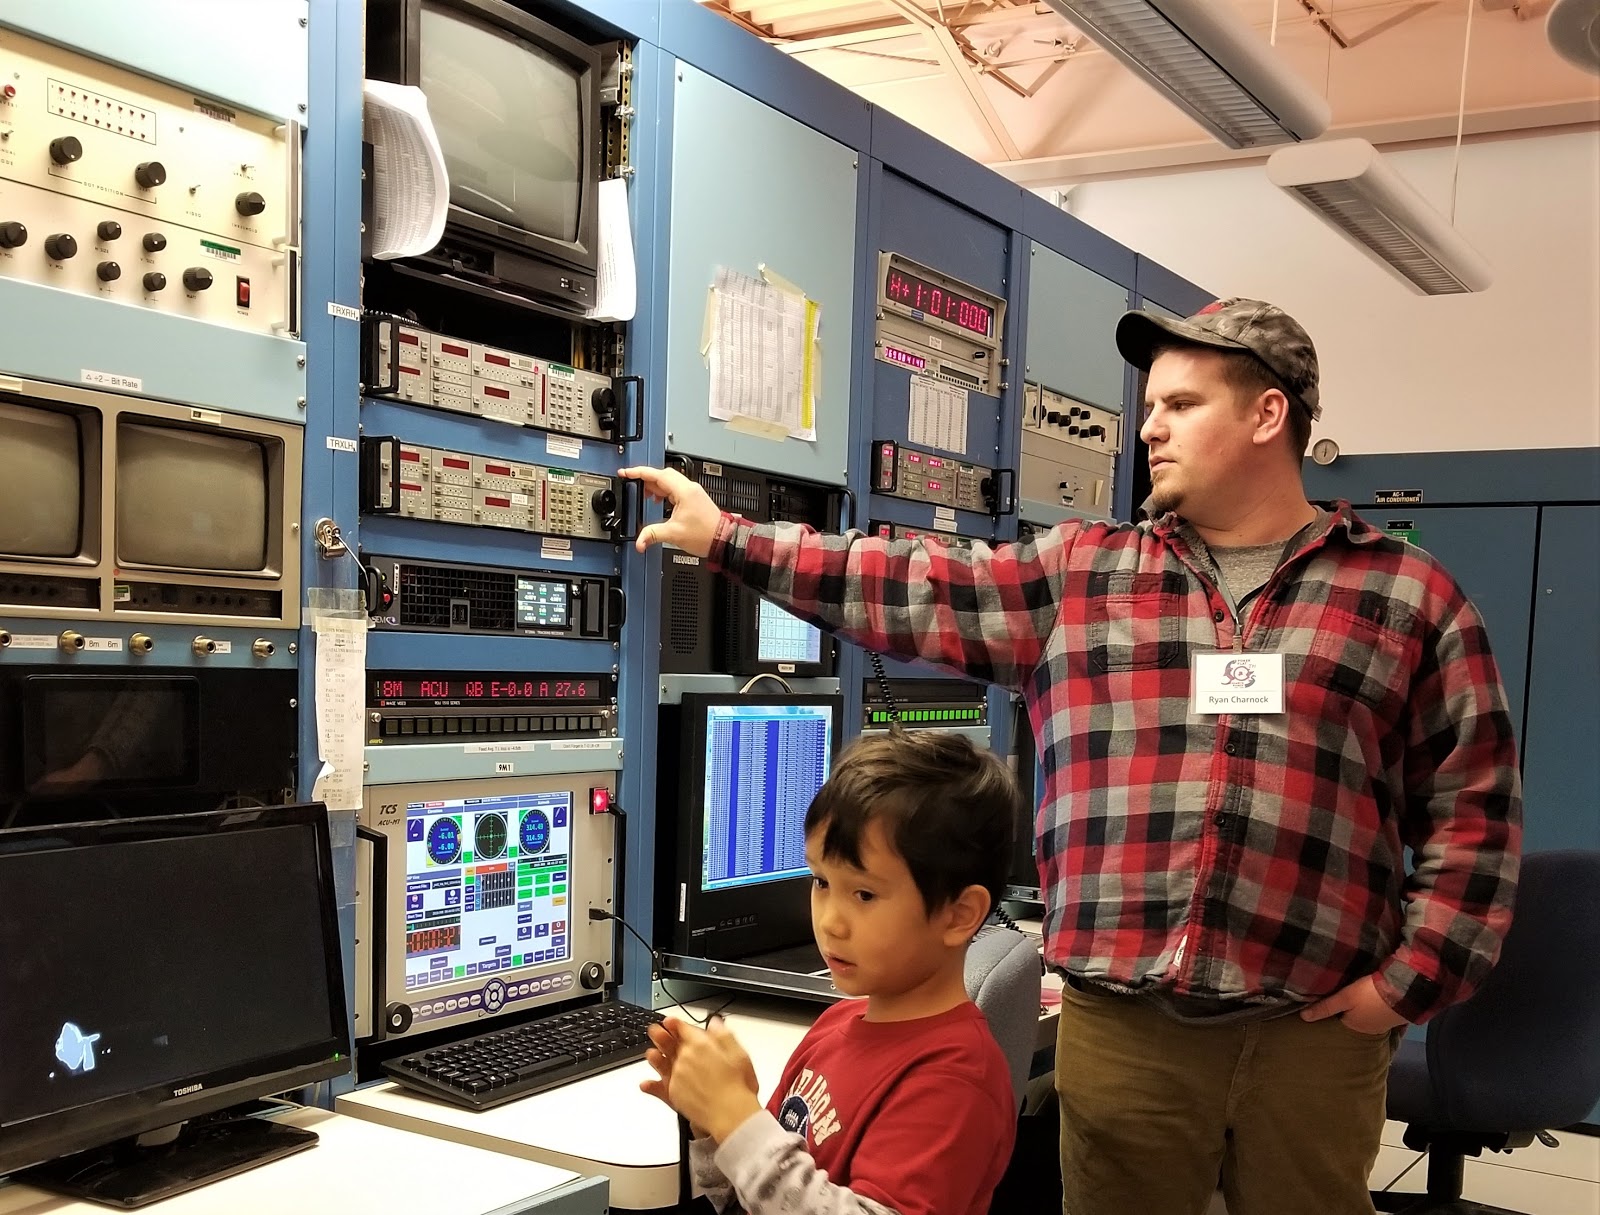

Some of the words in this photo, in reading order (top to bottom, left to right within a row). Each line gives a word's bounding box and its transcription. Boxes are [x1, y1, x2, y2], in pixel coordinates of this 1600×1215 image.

[111, 377, 121, 386] Bit
[122, 379, 138, 389] Rate
[672, 554, 700, 566] FREQUENTIS
[88, 640, 99, 648] 8m
[107, 641, 118, 649] 6m
[420, 681, 449, 697] ACU
[539, 681, 549, 697] A
[555, 682, 586, 697] 27.6
[1208, 695, 1229, 705] Ryan
[1230, 695, 1269, 704] Charnock
[379, 804, 398, 815] TCS
[482, 961, 497, 970] Targets
[173, 1083, 203, 1097] TOSHIBA
